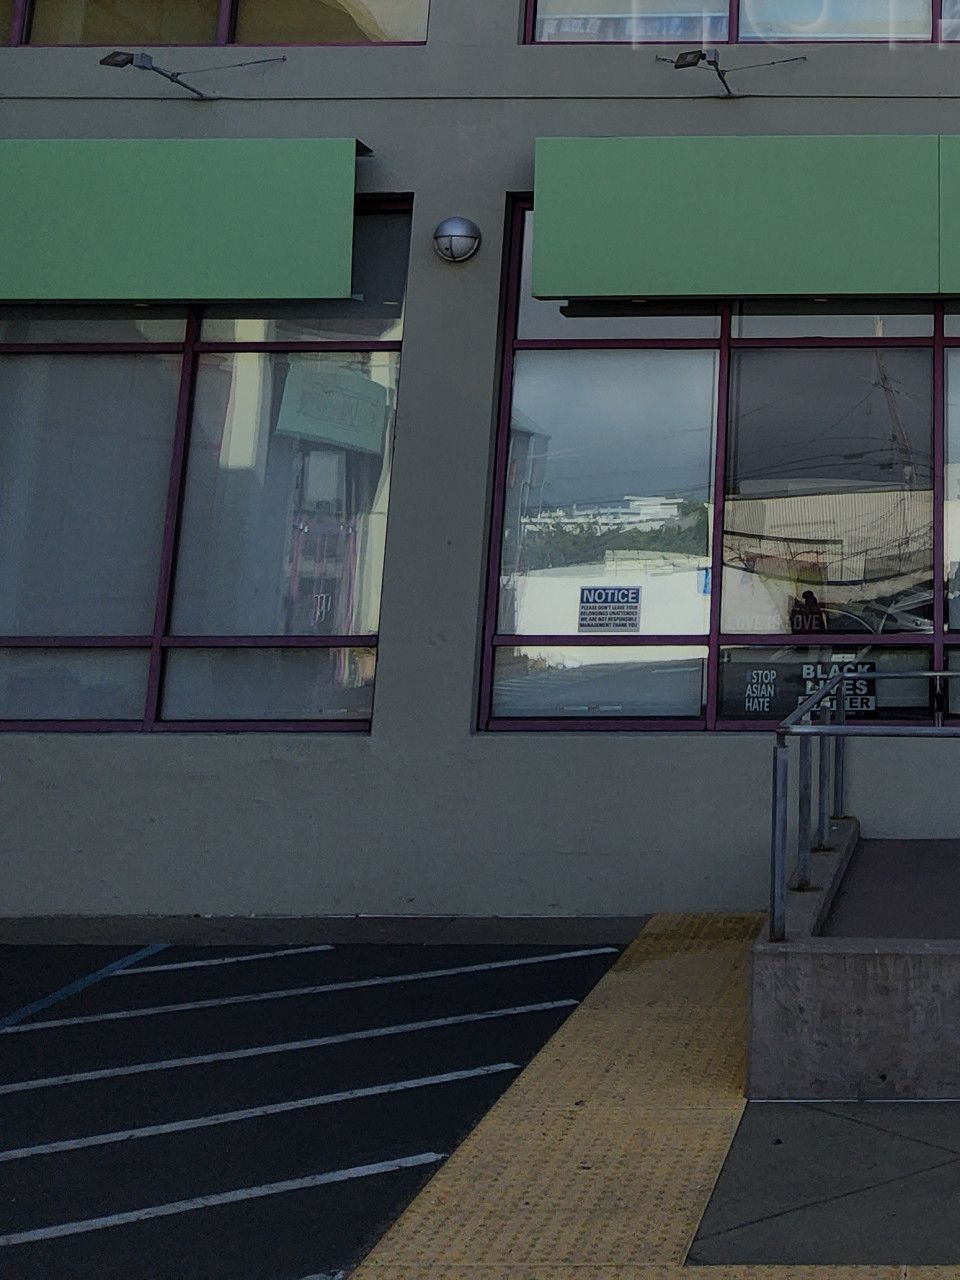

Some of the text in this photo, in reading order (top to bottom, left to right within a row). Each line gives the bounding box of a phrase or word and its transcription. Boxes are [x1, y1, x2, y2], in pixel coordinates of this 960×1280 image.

[583, 589, 637, 603] NOTICE
[752, 670, 777, 683] STOP
[745, 684, 774, 697] ASIAN
[745, 697, 770, 711] HATE
